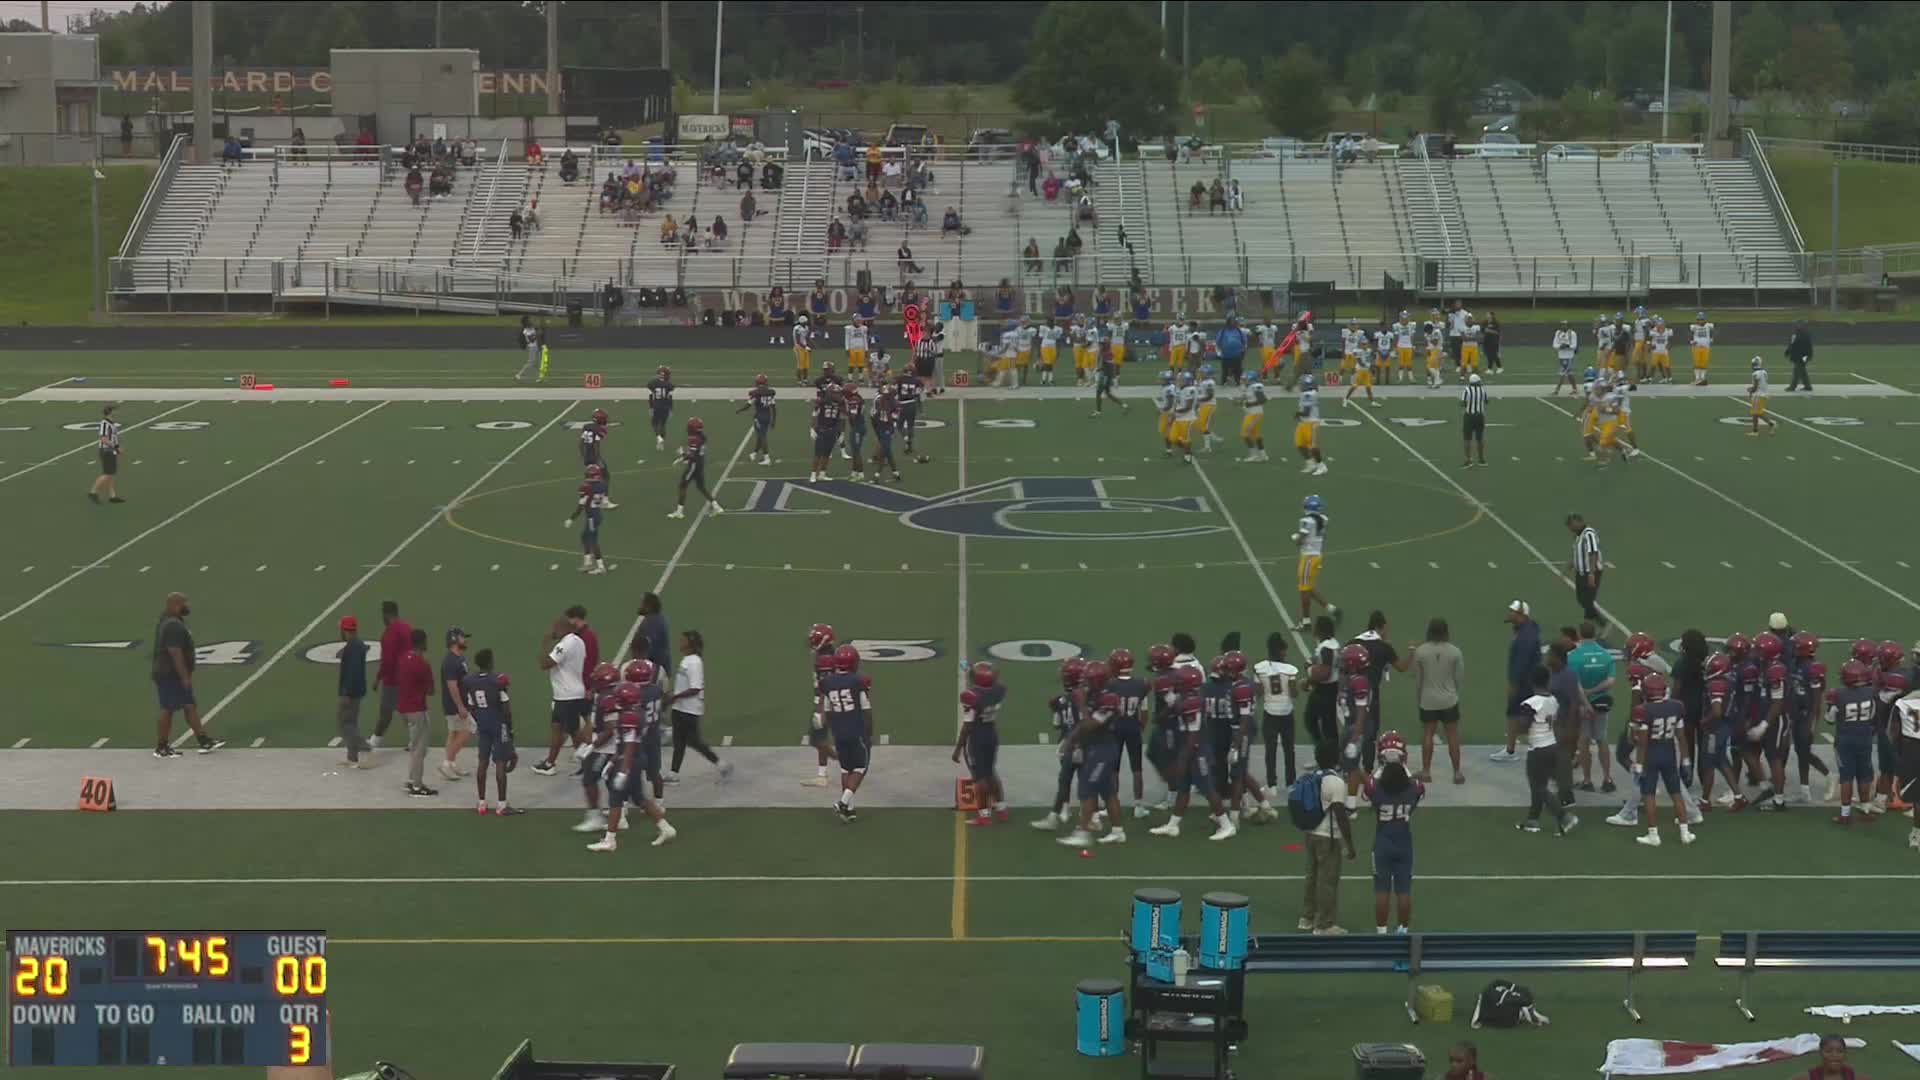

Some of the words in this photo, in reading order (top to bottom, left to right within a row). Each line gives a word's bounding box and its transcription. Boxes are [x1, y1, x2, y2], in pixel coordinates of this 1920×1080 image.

[112, 70, 294, 92] MALARD
[241, 375, 253, 386] 30
[586, 375, 600, 386] 40
[955, 374, 968, 385] 50
[828, 688, 855, 713] 92
[80, 778, 107, 804] 40
